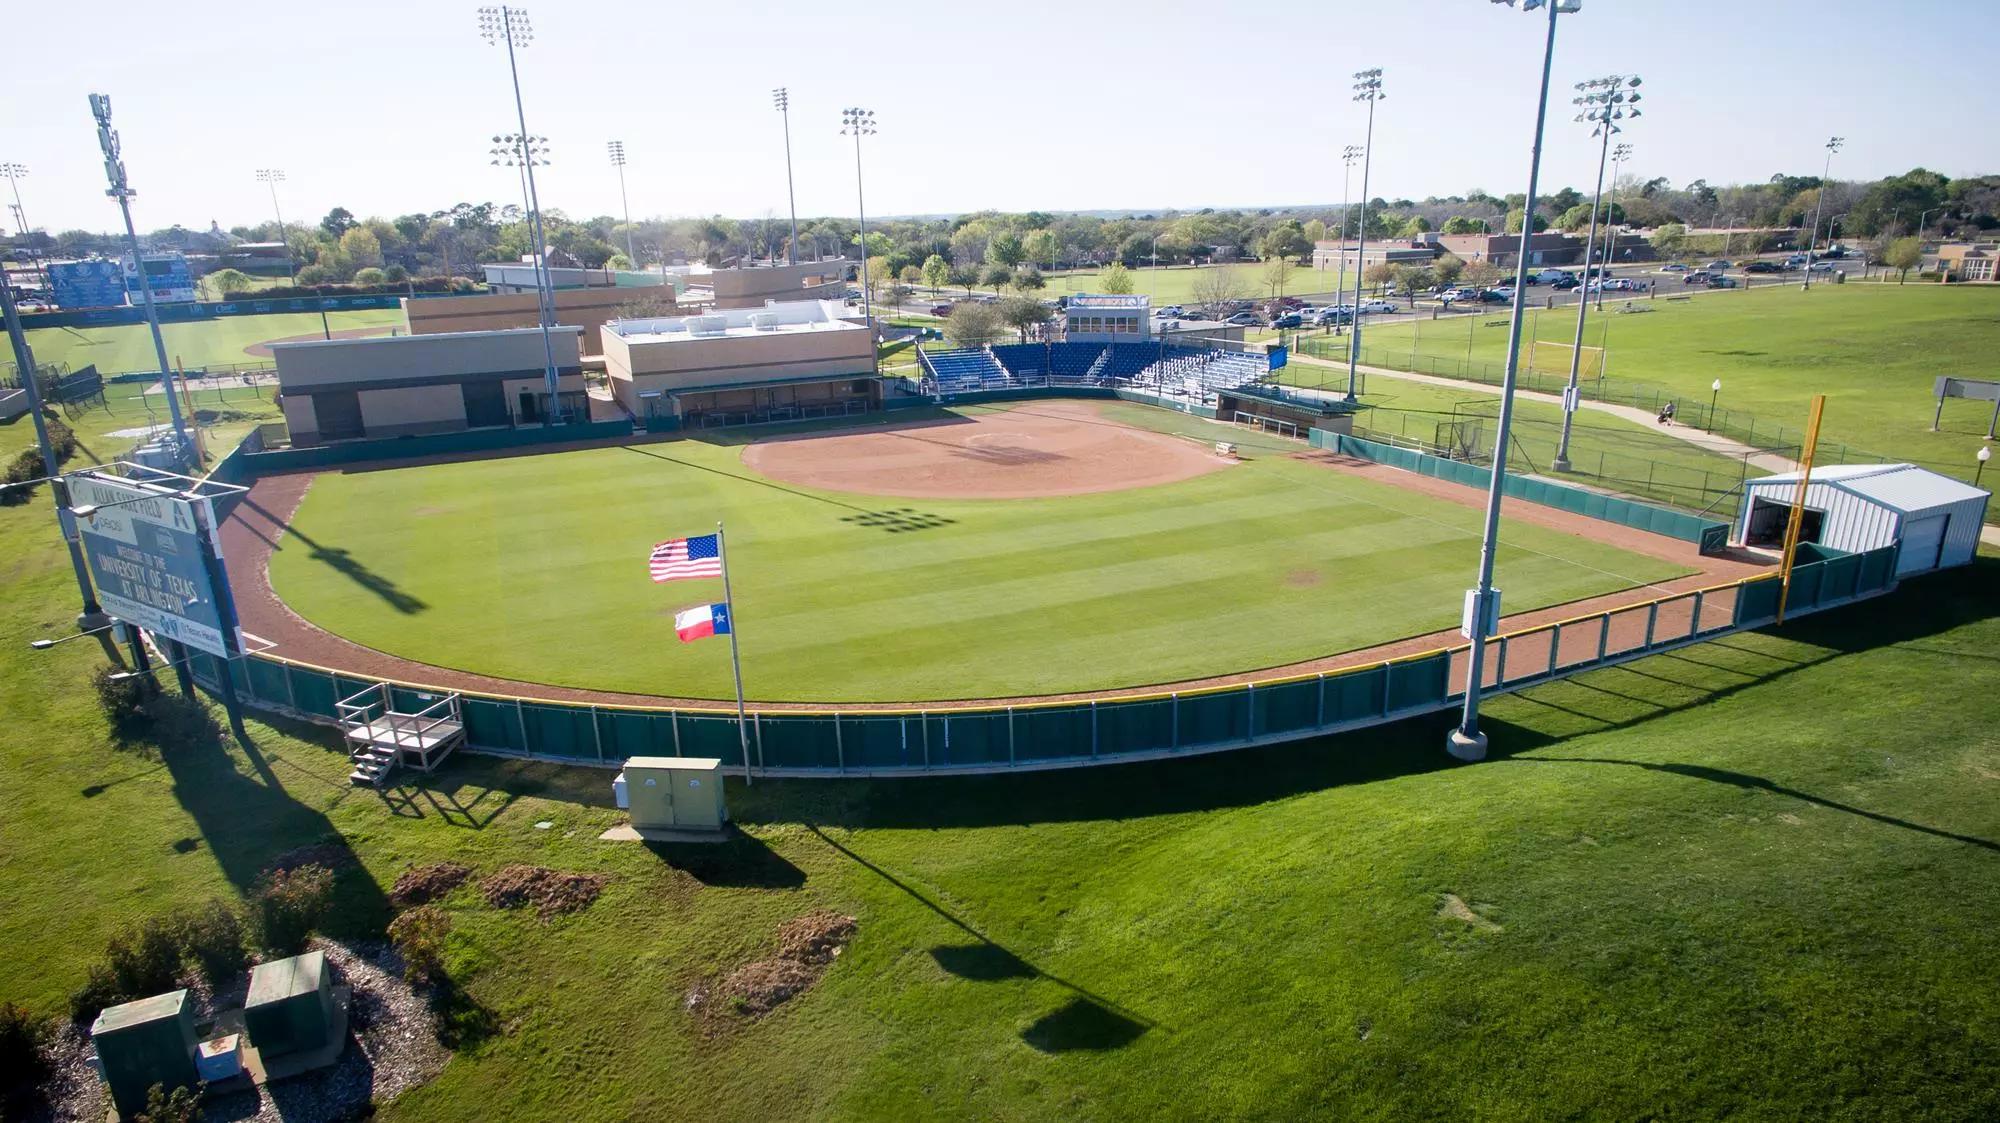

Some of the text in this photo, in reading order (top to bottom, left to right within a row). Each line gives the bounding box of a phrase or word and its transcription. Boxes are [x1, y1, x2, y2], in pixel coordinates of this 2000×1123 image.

[139, 498, 162, 519] FIELD
[97, 553, 198, 600] UNIVERSITY OF TEXAS
[121, 580, 133, 598] AT
[134, 583, 185, 615] ARLINGTON
